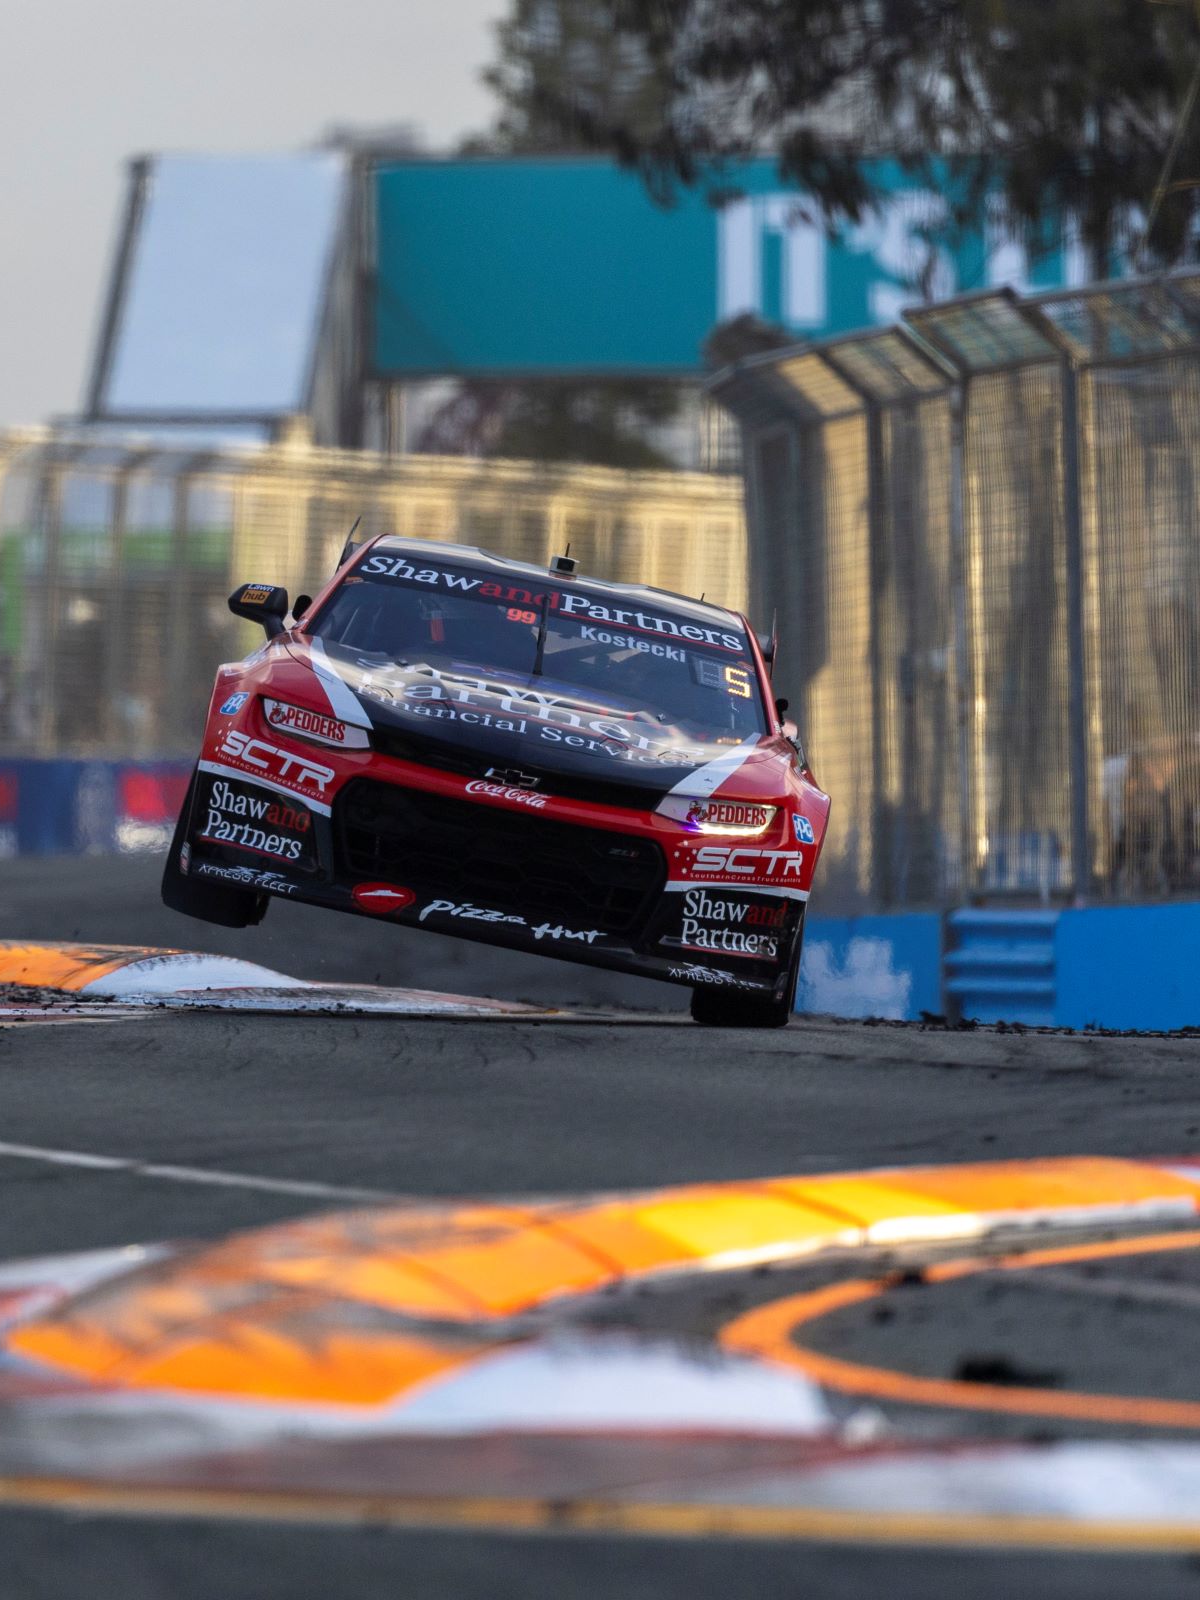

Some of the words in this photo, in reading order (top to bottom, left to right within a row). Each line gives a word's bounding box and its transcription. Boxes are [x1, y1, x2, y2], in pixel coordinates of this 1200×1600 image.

[244, 592, 266, 600] hub
[361, 556, 482, 591] Shaw
[560, 594, 744, 652] Partners
[506, 607, 537, 624] 99
[581, 625, 687, 663] Kostecki
[725, 666, 751, 698] 5
[284, 706, 346, 741] PEDDERS
[221, 730, 336, 792] SCTR
[540, 725, 696, 767] Services
[210, 781, 270, 820] Shaw
[708, 804, 767, 827] PEDDERS
[201, 808, 302, 859] Partners
[199, 864, 255, 883] XPRESS
[254, 875, 298, 894] FLEET
[692, 847, 803, 875] SCTR
[418, 899, 527, 922] Pizza
[531, 923, 608, 943] Hut
[683, 889, 749, 923] Shaw
[681, 918, 779, 957] Partners
